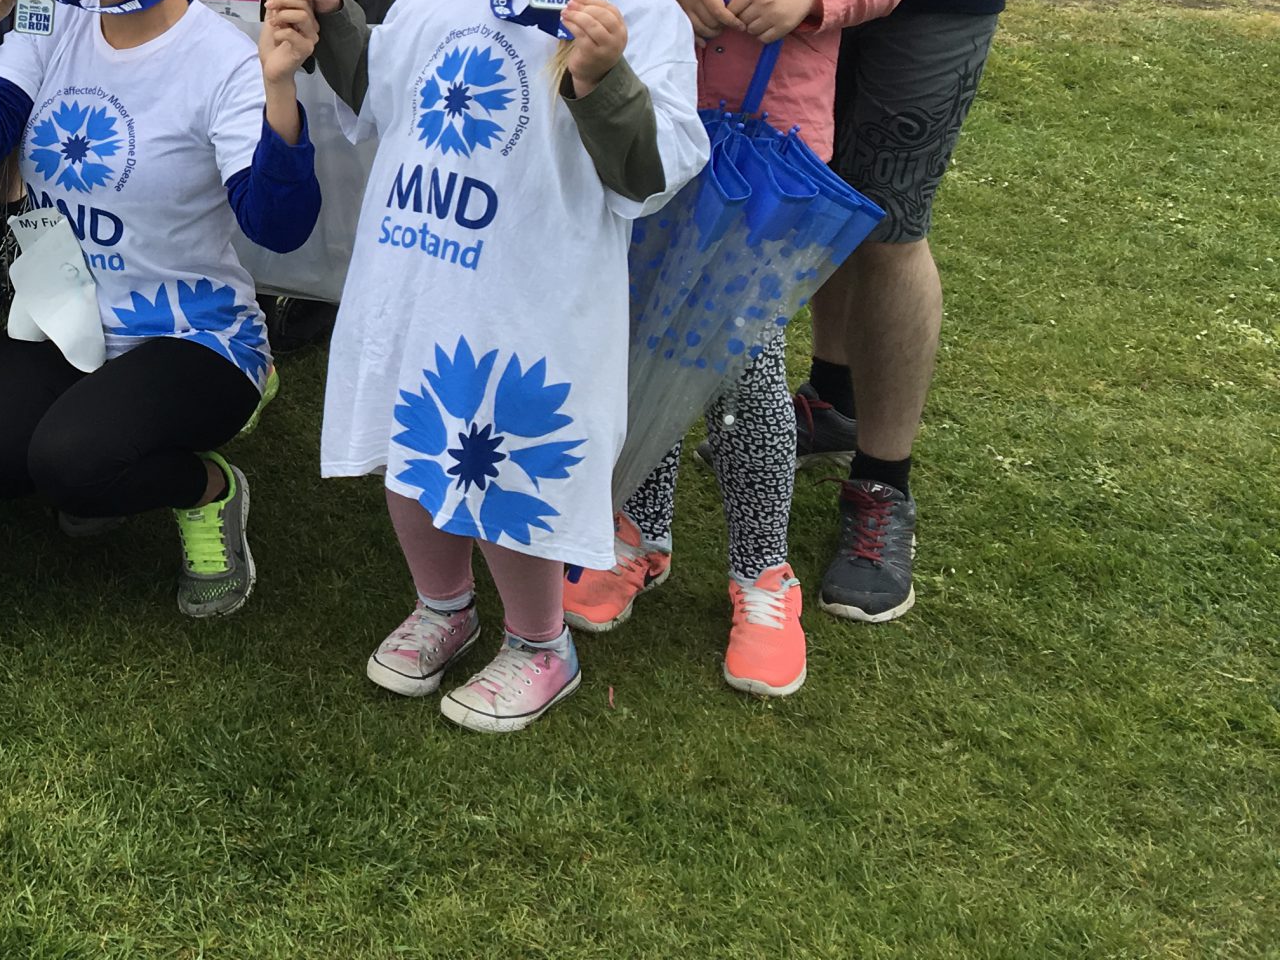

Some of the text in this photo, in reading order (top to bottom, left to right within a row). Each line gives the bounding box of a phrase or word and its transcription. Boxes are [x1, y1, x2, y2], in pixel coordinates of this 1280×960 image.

[18, 3, 29, 29] 2017
[28, 22, 50, 32] RUN
[29, 13, 51, 23] FUN
[445, 24, 480, 44] affected
[480, 24, 494, 38] by
[492, 31, 519, 61] Motor
[63, 86, 97, 96] affected
[97, 86, 110, 100] by
[515, 59, 530, 113] Neurone
[107, 95, 130, 119] Motor
[126, 118, 137, 157] Neurone
[500, 115, 530, 157] Disease
[114, 158, 137, 192] Disease
[386, 162, 499, 230] MND
[19, 218, 38, 229] My
[378, 216, 484, 270] Scotand
